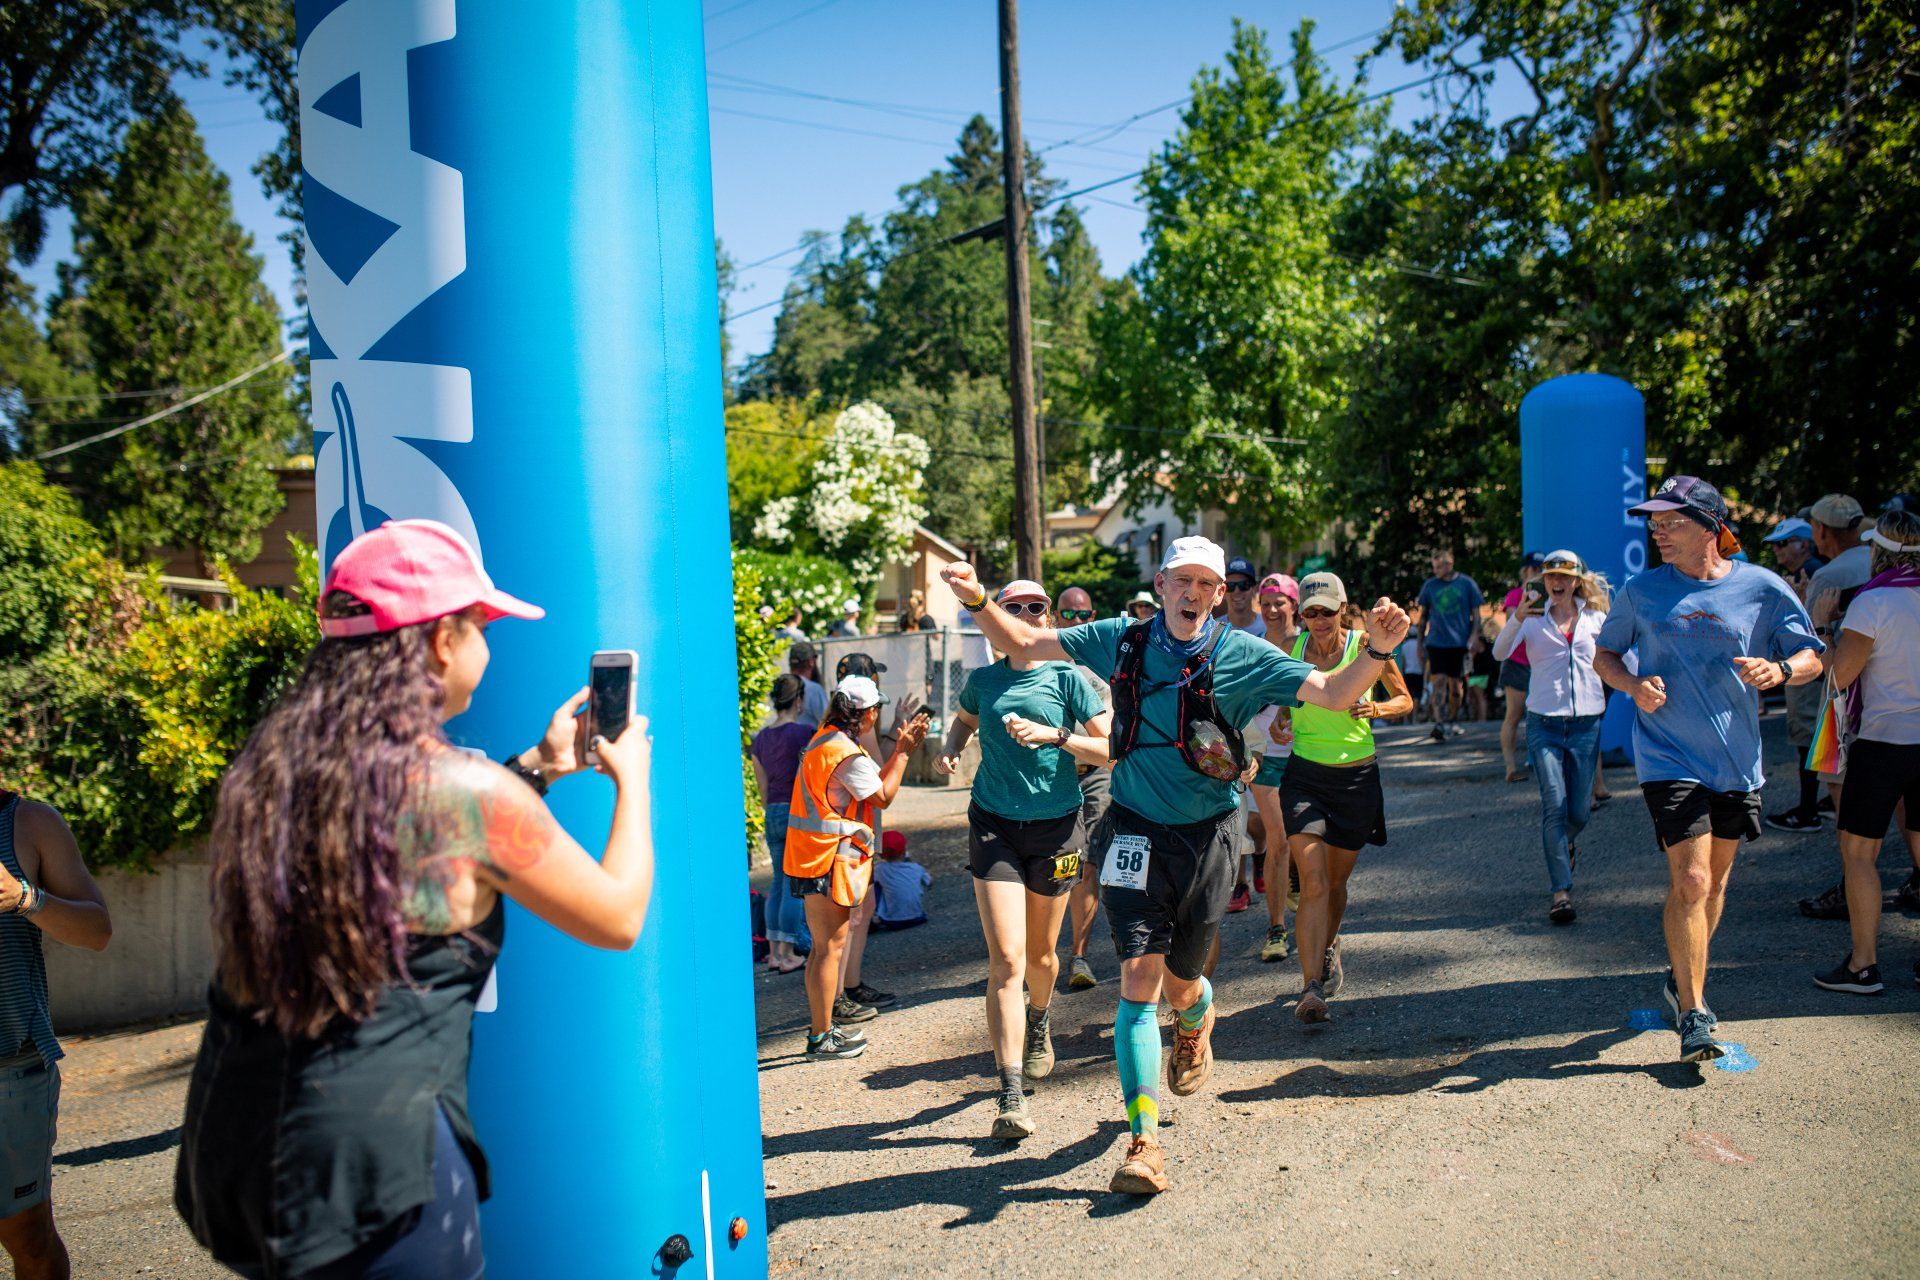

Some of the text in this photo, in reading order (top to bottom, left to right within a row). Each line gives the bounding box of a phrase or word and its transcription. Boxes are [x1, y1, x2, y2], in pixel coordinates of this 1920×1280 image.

[1624, 540, 1645, 580] O
[1061, 855, 1078, 874] 92
[1116, 849, 1143, 872] 58
